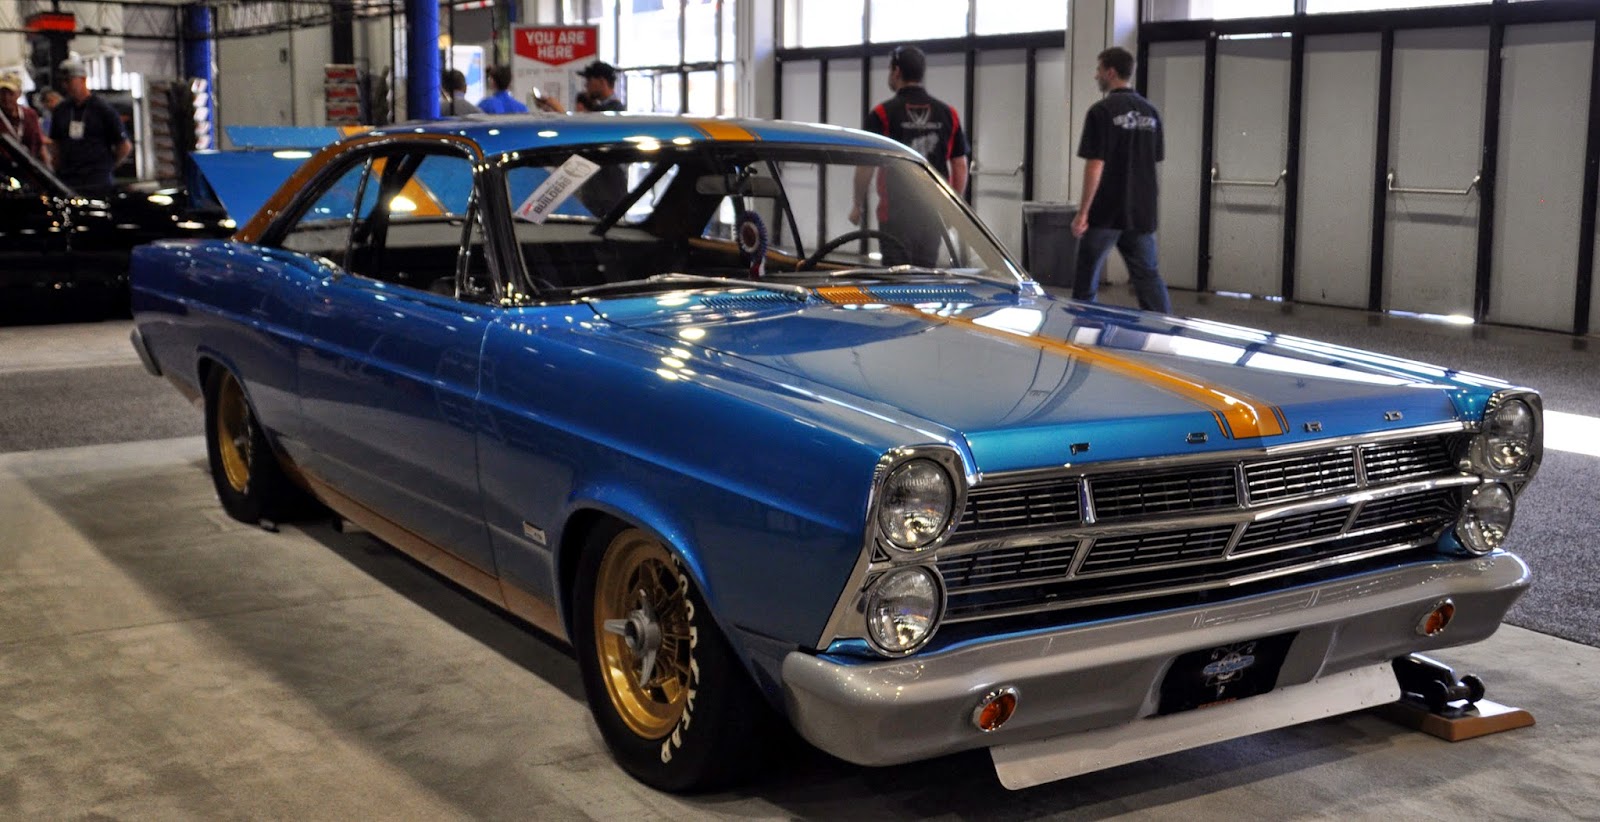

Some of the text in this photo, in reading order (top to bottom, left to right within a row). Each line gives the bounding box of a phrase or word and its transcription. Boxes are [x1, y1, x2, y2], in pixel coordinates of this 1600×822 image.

[525, 31, 586, 46] YOU ARE
[537, 45, 574, 59] HERE
[533, 176, 573, 214] BUILDERS
